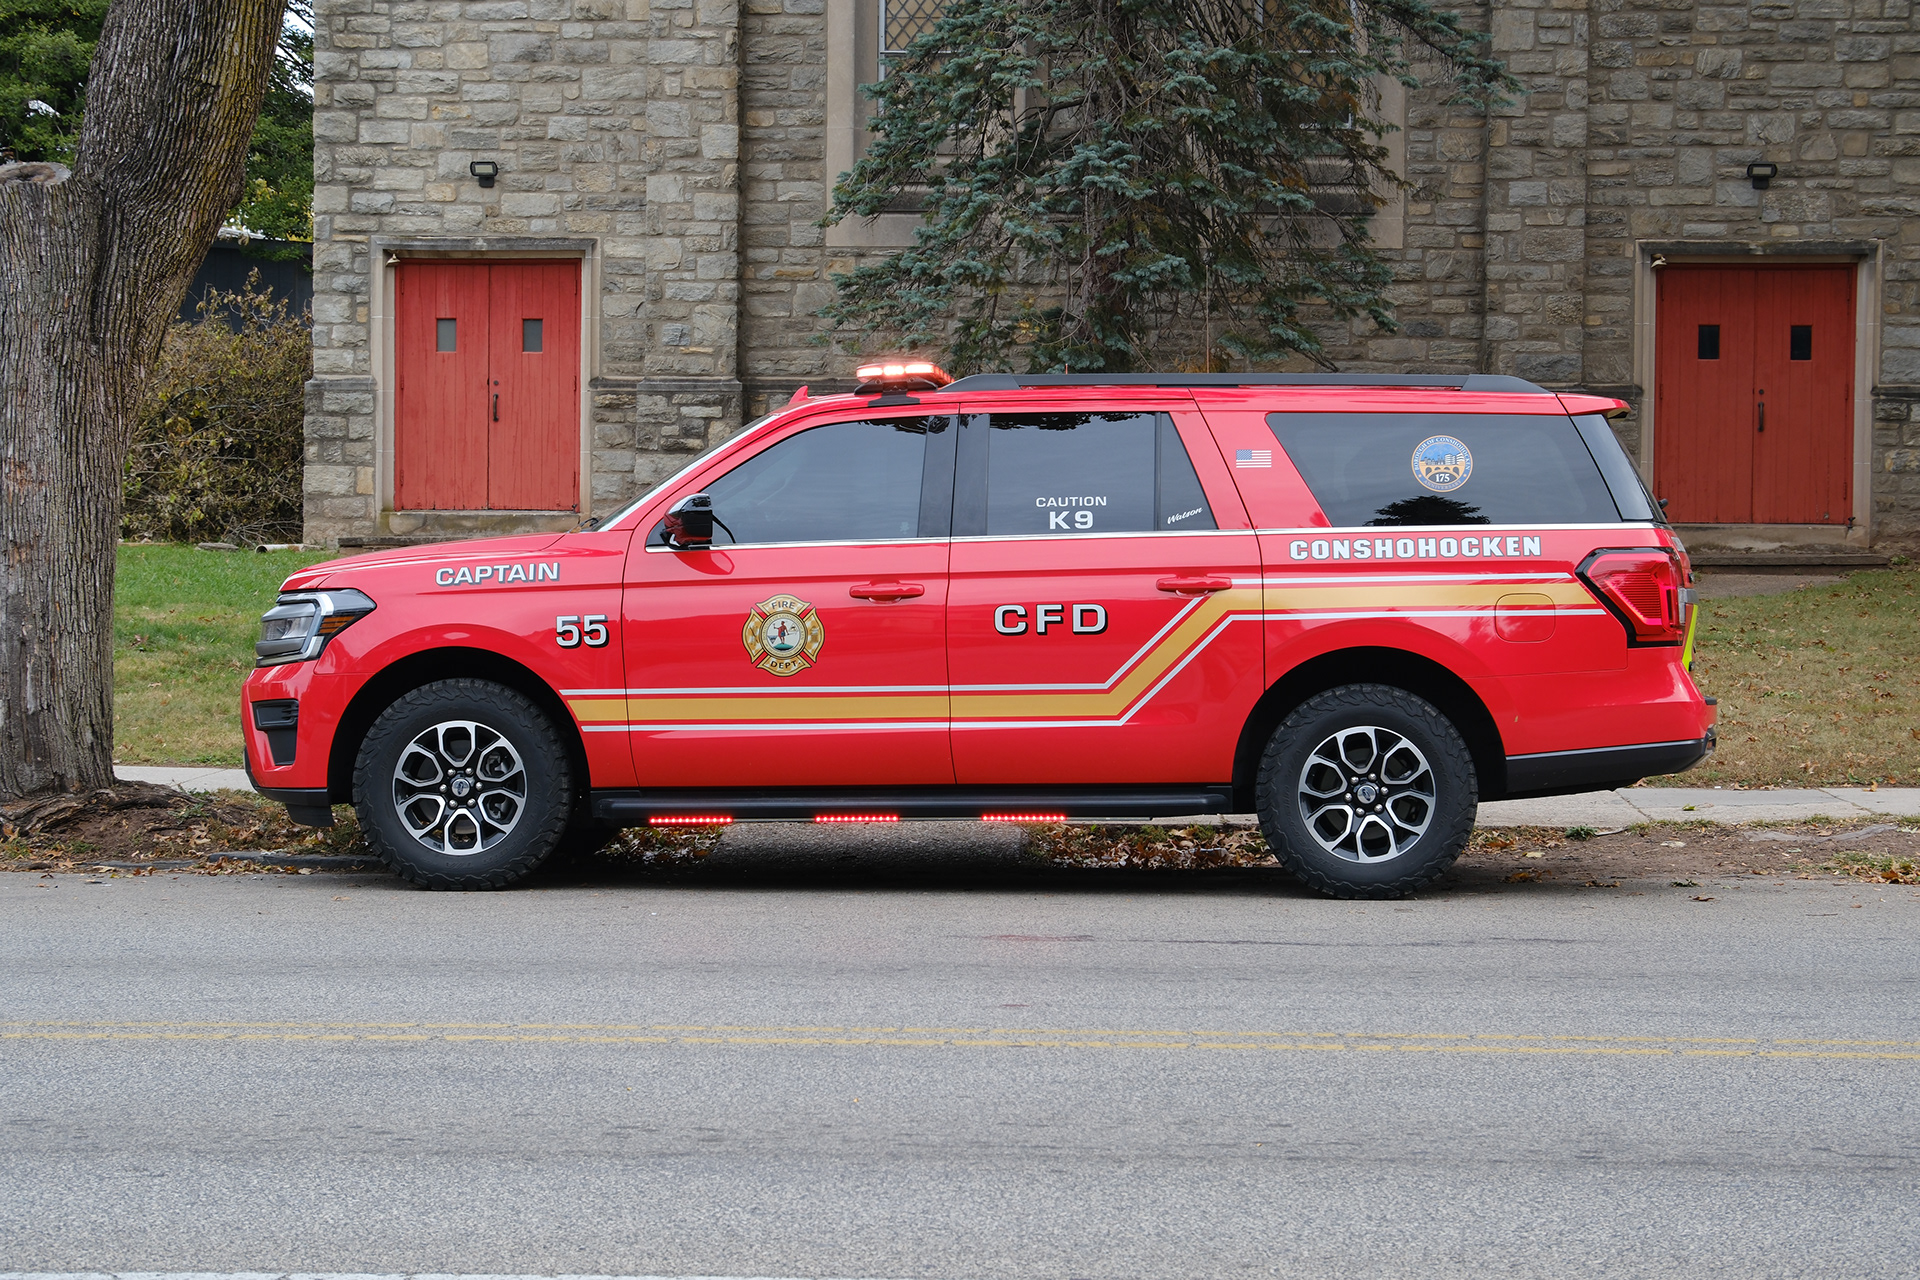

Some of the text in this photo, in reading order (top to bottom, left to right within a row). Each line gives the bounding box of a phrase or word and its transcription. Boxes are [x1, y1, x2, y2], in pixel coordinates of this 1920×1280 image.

[1435, 473, 1450, 482] 175
[1036, 496, 1107, 508] CAUTION
[1049, 510, 1094, 530] K9
[1167, 507, 1203, 525] Watson
[1289, 536, 1541, 560] CONSHOHOCKEN
[435, 562, 560, 586] CAPTAIN
[771, 600, 796, 610] FIRE
[994, 603, 1108, 635] CFD
[555, 614, 610, 649] 55
